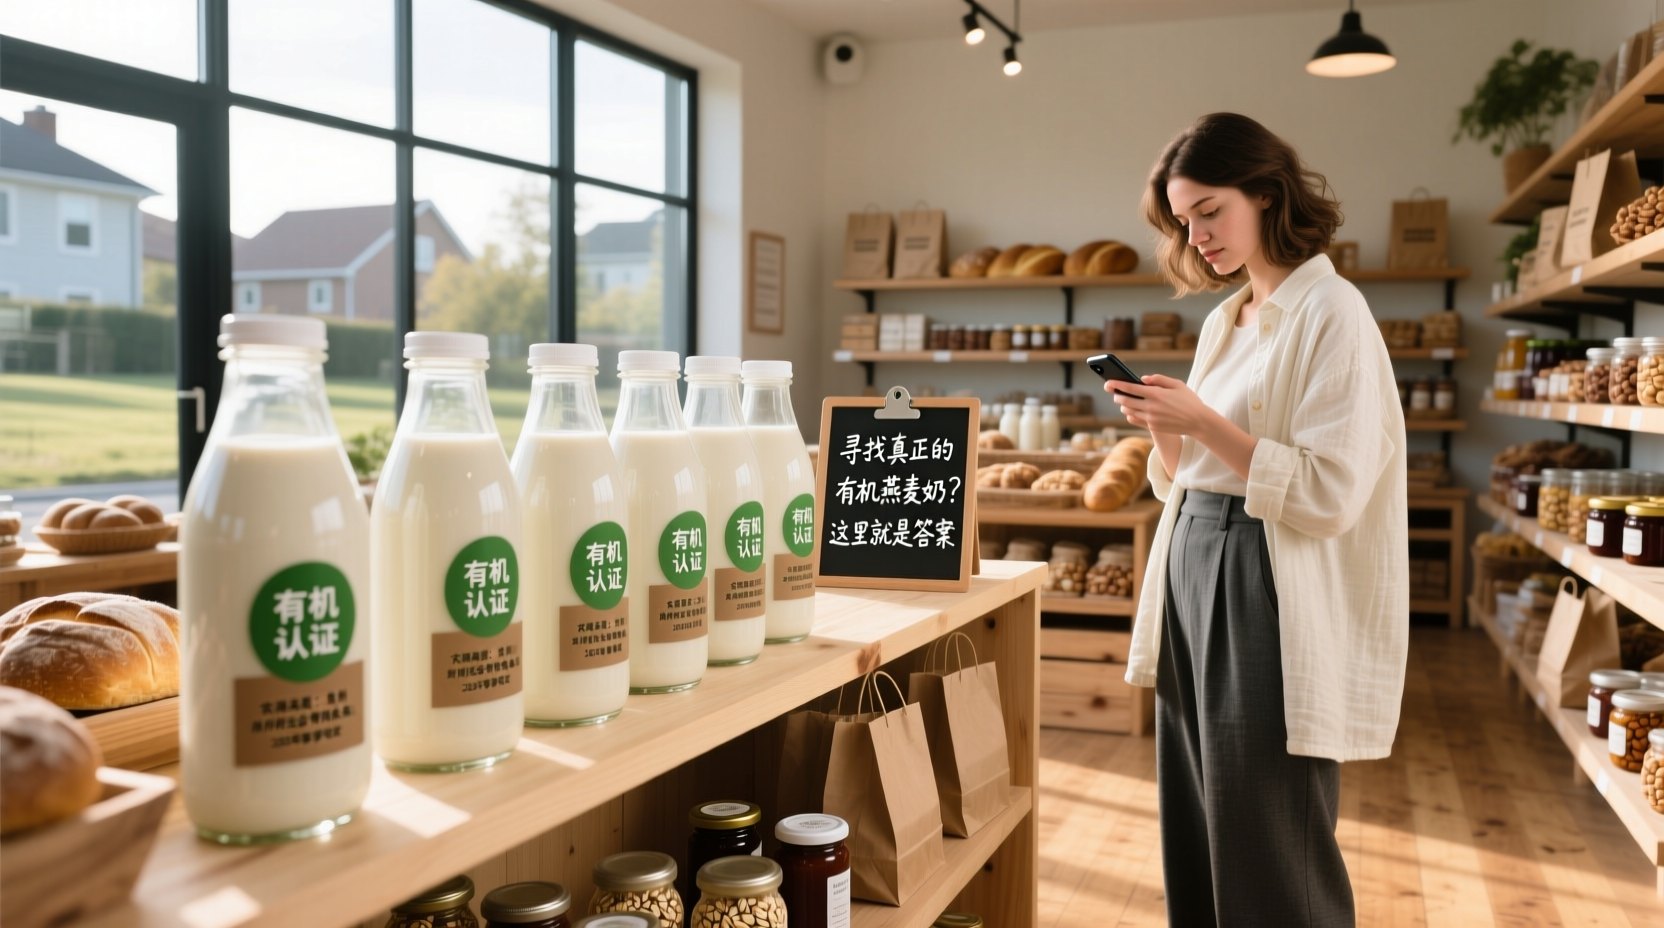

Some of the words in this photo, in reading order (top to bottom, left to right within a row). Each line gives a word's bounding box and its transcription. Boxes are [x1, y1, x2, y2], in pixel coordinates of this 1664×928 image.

[839, 432, 954, 466] 寻找真正的
[835, 473, 962, 506] 有机燕麦奶?
[736, 516, 762, 537] 有机
[792, 507, 813, 526] 有机
[671, 527, 703, 551] 有机
[792, 526, 813, 545] 认证
[828, 518, 956, 550] 这里就是答案
[585, 540, 623, 567] 有机
[736, 538, 762, 559] 认证
[463, 557, 510, 589] 有机
[672, 551, 703, 574] 认证
[585, 567, 623, 593] 认证
[273, 585, 341, 625] 有机
[463, 587, 510, 619] 认证
[273, 622, 341, 661] 认证
